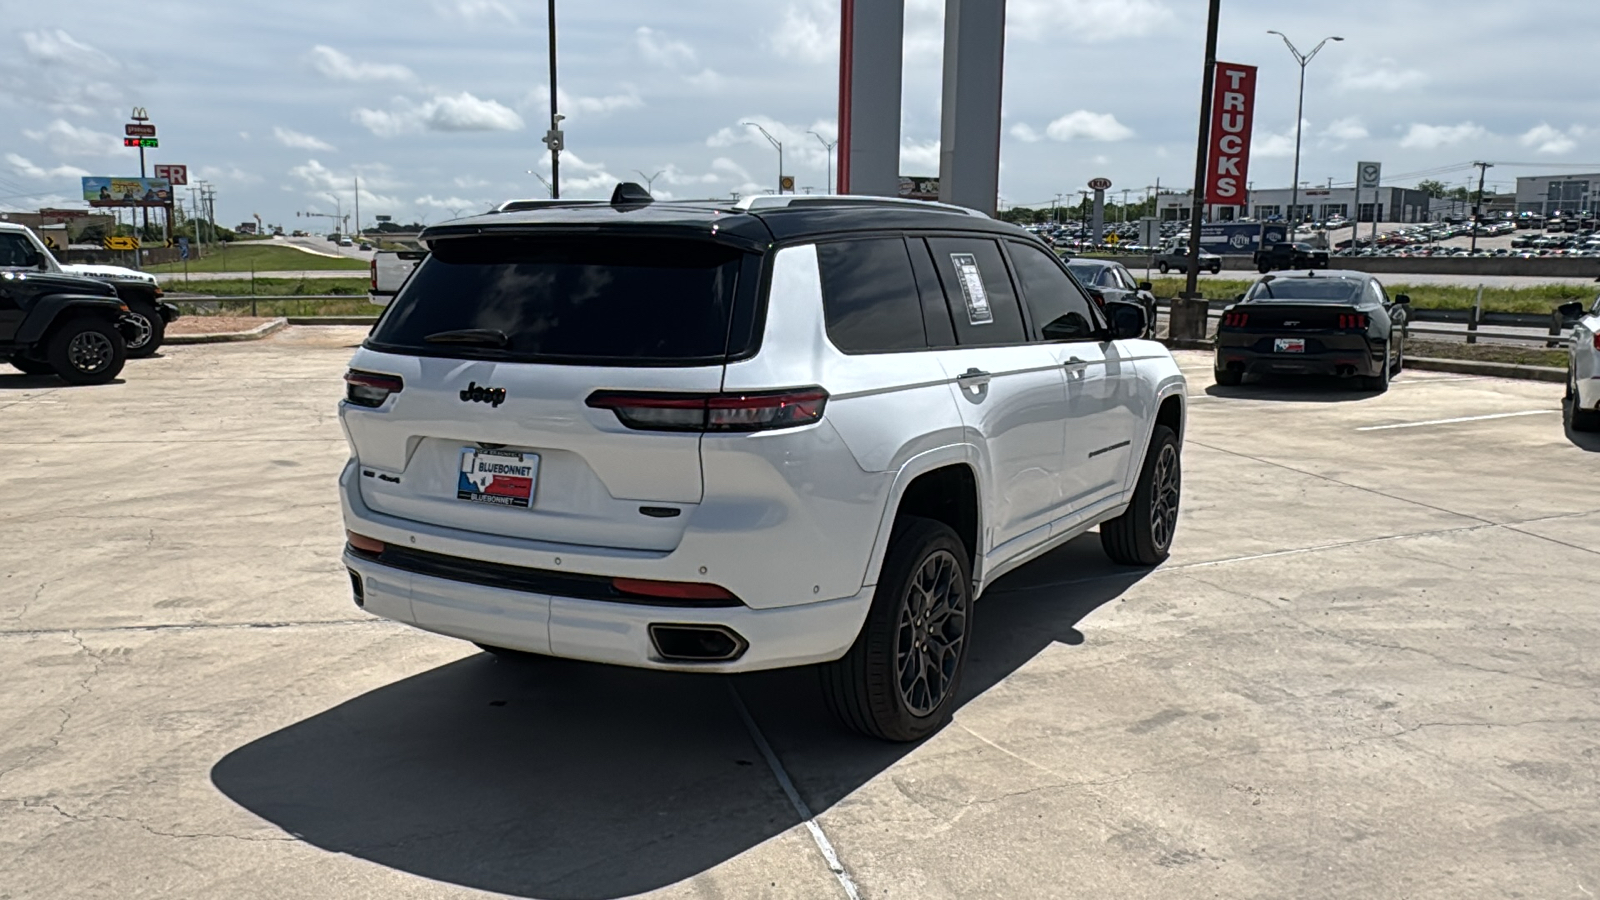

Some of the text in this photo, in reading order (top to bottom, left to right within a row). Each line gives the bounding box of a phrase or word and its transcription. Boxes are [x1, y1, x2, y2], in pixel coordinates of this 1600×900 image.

[1216, 70, 1246, 197] TRUCKS
[479, 462, 532, 476] BLUEBONNET
[471, 493, 514, 505] BLUEBONNET
